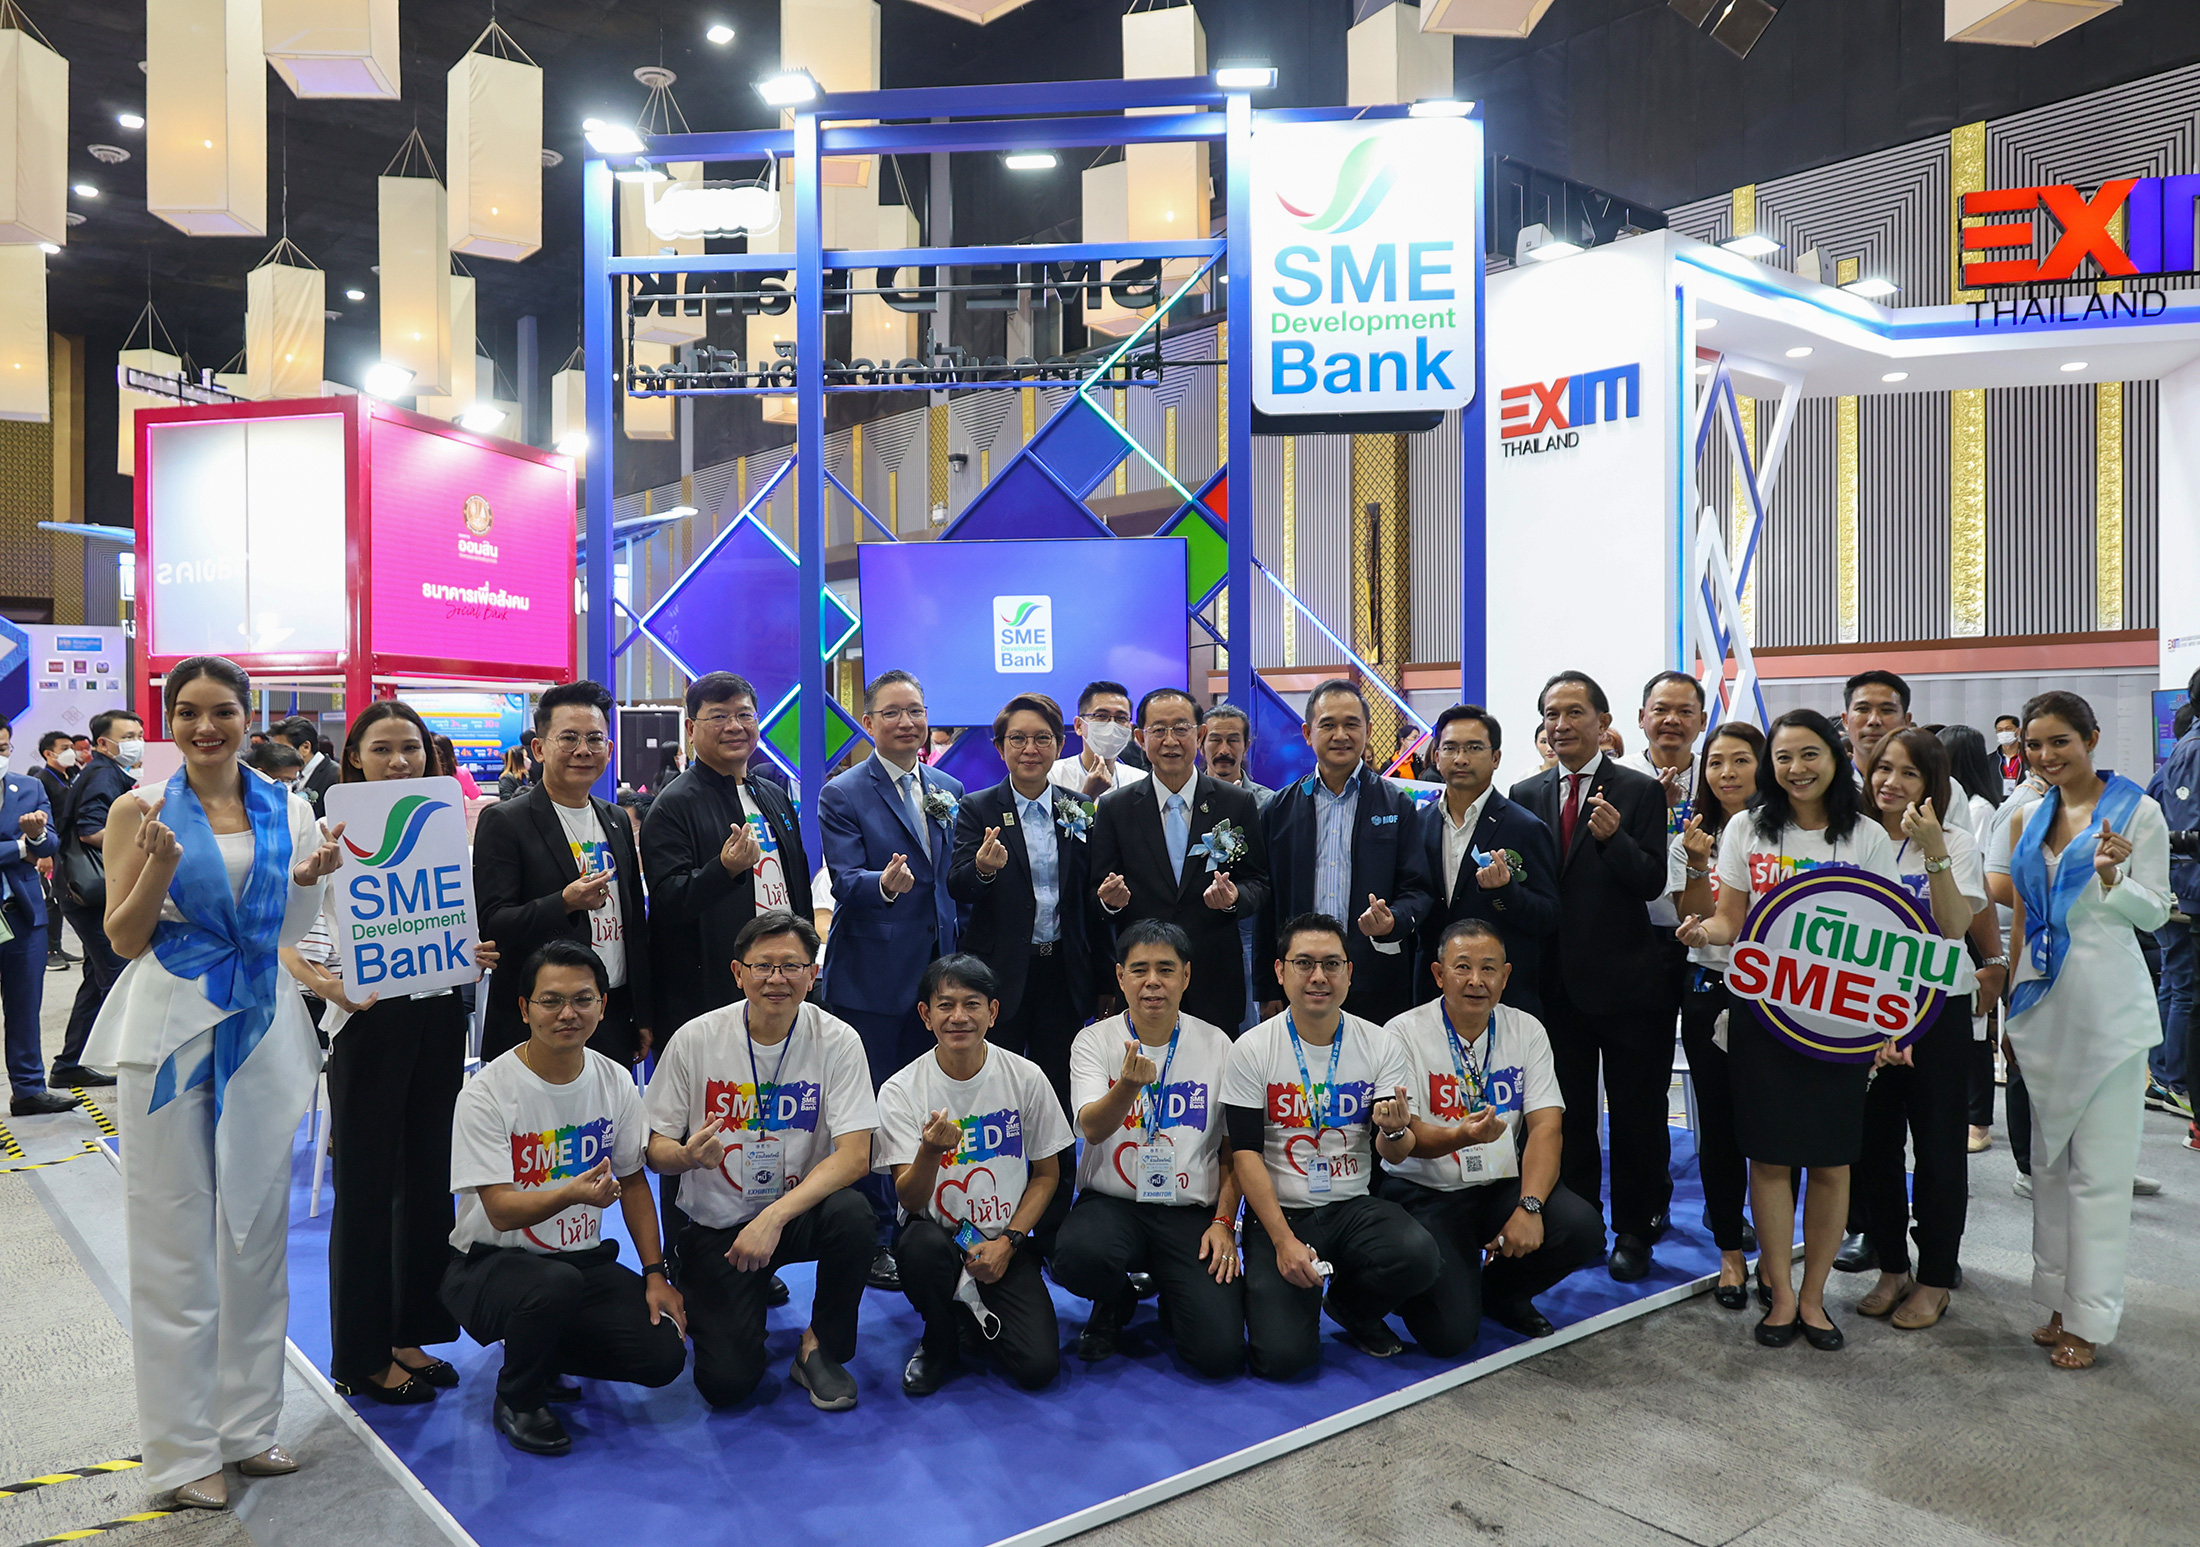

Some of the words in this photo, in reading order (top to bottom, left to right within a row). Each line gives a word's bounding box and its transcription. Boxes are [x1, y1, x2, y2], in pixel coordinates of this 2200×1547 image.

[1272, 241, 1455, 306] SME
[1271, 307, 1456, 335] Development
[1966, 289, 2167, 328] THAILAND
[1271, 336, 1456, 395] Bank
[1501, 362, 1640, 439] EXIM
[1501, 431, 1579, 458] THAILAND
[458, 540, 498, 558] ออมสิน
[422, 581, 529, 610] ธนาคารเพื่อสังคม
[445, 599, 480, 619] Social
[1001, 629, 1046, 644] SME
[1001, 652, 1046, 666] Bank
[1382, 815, 1399, 825] MOF
[349, 864, 465, 921] SME
[351, 910, 466, 940] Development
[354, 931, 470, 985] Bank
[1790, 905, 1961, 992] เติมทุน
[1729, 947, 1910, 1030] SMEs
[1168, 1093, 1186, 1118] D
[1339, 1094, 1358, 1117] D
[1493, 1081, 1513, 1105] D
[777, 1095, 797, 1120] D
[983, 1125, 1003, 1149] D
[520, 1138, 573, 1173] SME
[581, 1135, 598, 1163] D
[967, 1195, 1011, 1223] ให้ใจ
[556, 1212, 596, 1246] ให้ใจ
